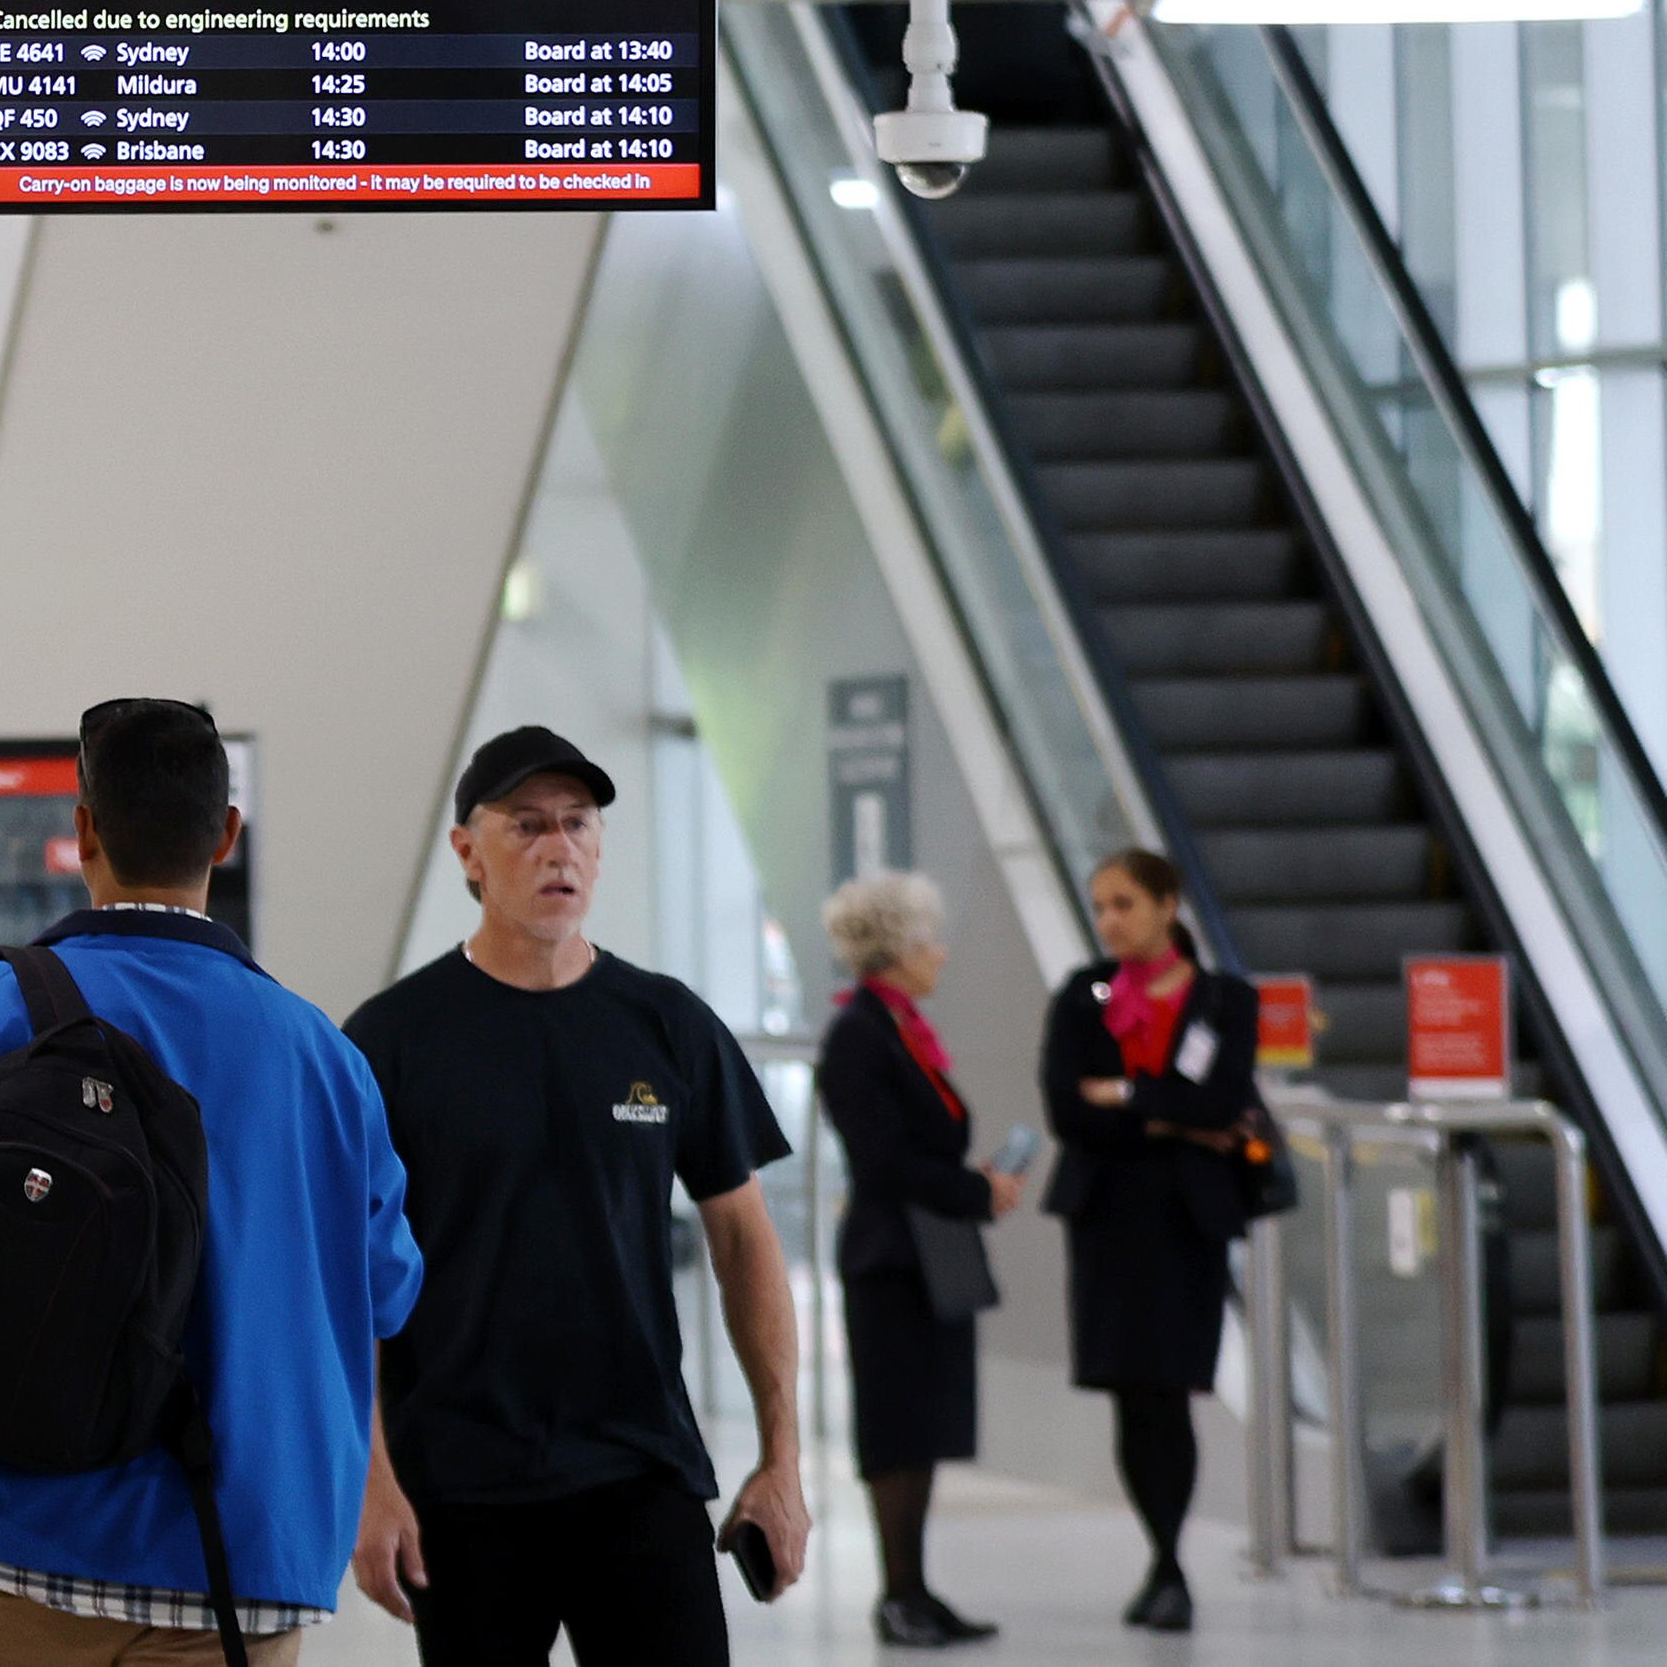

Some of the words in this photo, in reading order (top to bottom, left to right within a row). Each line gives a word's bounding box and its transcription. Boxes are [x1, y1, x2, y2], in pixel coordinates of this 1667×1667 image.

[93, 8, 133, 30] due
[137, 10, 161, 29] to
[165, 8, 289, 34] engineering
[294, 8, 430, 33] requirements
[20, 140, 70, 161] 9083
[117, 139, 205, 161] Brisbane
[311, 139, 366, 160] 14:30
[525, 137, 586, 159] Board
[590, 140, 613, 159] at
[618, 138, 673, 158] 14:10
[19, 175, 92, 196] Carry-on
[94, 175, 167, 195] baggage
[170, 175, 184, 192] is
[186, 178, 221, 192] now
[223, 174, 270, 194] being
[273, 174, 357, 191] monitored
[370, 174, 383, 191] it
[385, 177, 421, 194] may
[423, 174, 445, 190] be
[447, 173, 516, 193] required
[518, 174, 537, 190] to
[539, 173, 561, 190] be
[562, 173, 632, 190] checked
[634, 172, 651, 189] in
